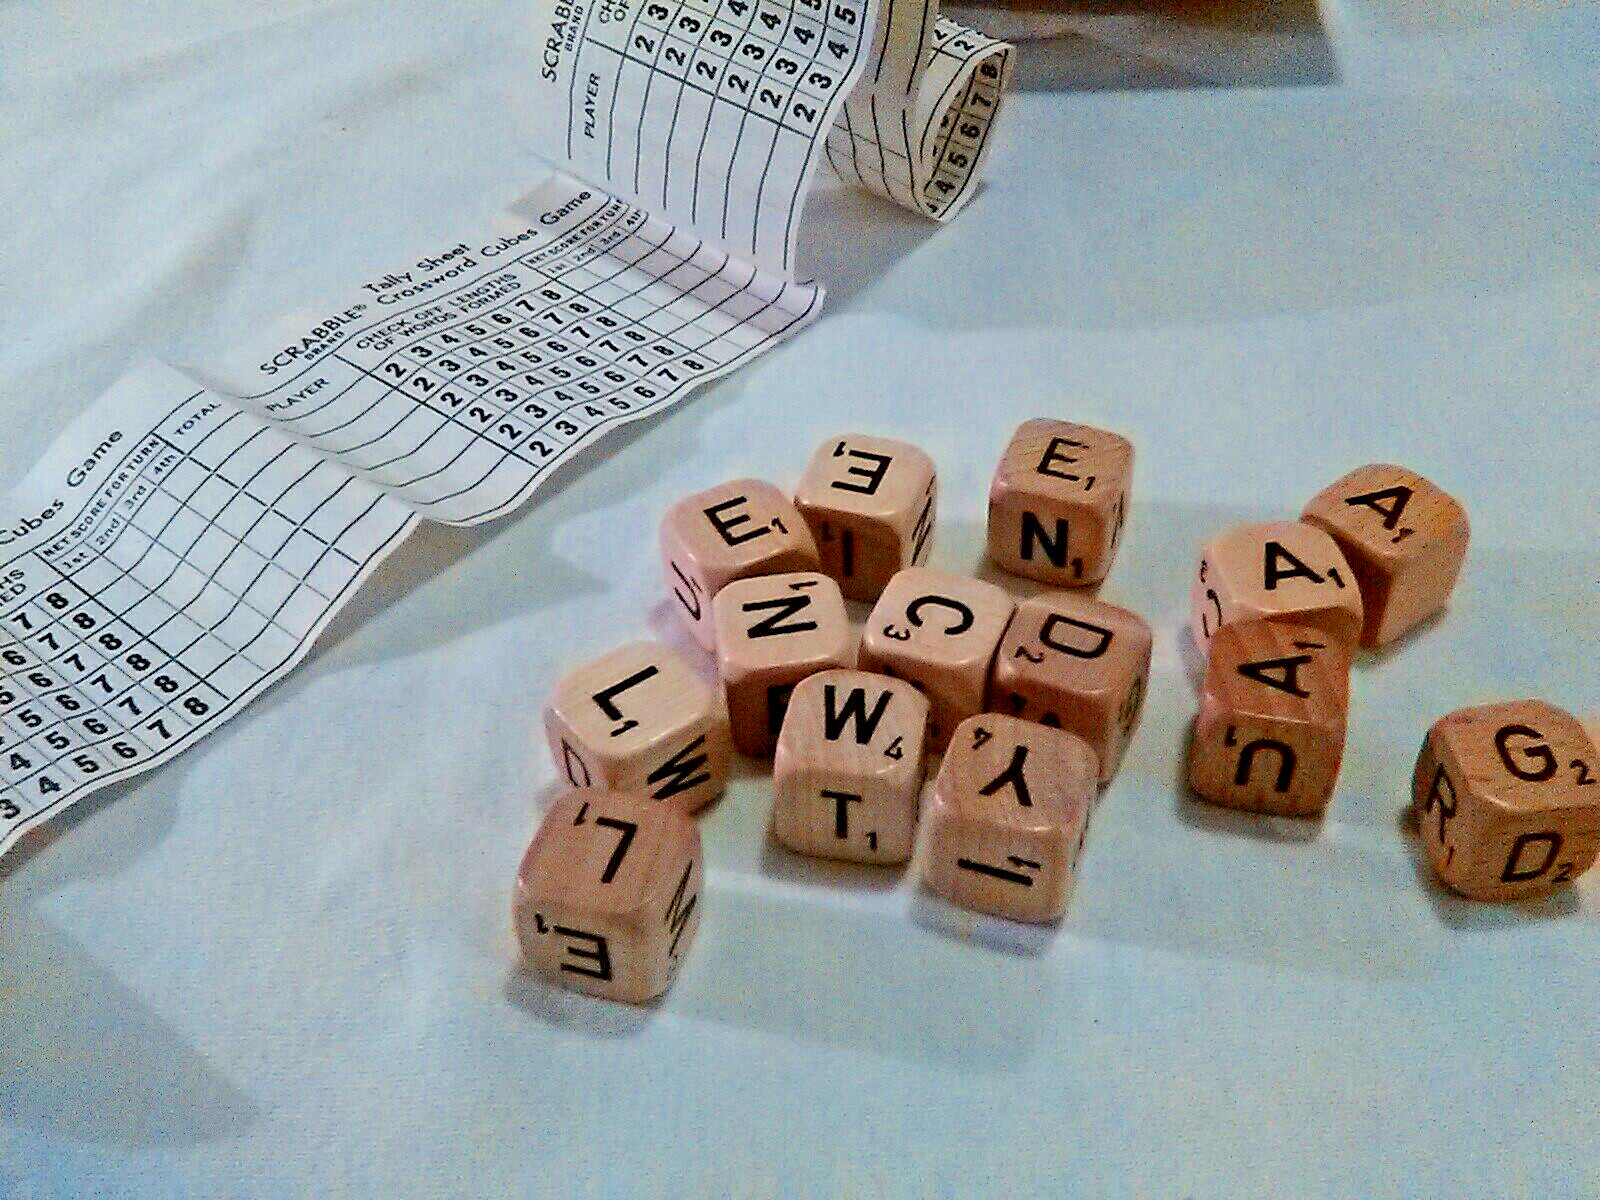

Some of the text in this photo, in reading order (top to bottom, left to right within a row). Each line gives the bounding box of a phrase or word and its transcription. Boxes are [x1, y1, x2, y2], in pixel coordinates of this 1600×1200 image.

[635, 4, 668, 53] 2 3
[665, 16, 700, 66] 2 3
[696, 30, 732, 79] 2 3
[728, 12, 781, 94] 2 3 4
[760, 26, 814, 108] 2 3 4
[794, 5, 856, 123] 2 3 4 5
[585, 73, 600, 138] PLAYER
[960, 123, 980, 139] 6
[971, 92, 991, 107] 7
[362, 243, 471, 293] Tally Sheet
[377, 191, 591, 305] Crossword Cubes Game
[356, 319, 411, 349] CHECK
[448, 273, 518, 307] LENGTHS
[373, 282, 521, 351] OF WORDS FORMED
[385, 290, 561, 378] 2 3 4 5 6 7 8
[413, 303, 589, 392] 2 3 4 5 6 7 8
[440, 317, 617, 407] 2 3 4 5 6 7 8
[266, 378, 328, 412] PLAYER
[469, 331, 646, 422] 2 3 4 5 6 7 8
[499, 346, 674, 440] 2 3 4 5 6 7 8
[173, 402, 222, 436] TOTAL
[529, 360, 704, 457] 2 3 4 5 6 7 8
[67, 430, 123, 487] Game
[831, 450, 892, 495] E
[1037, 437, 1089, 481] E
[43, 439, 160, 557] NET SCORE FOR TURN
[703, 496, 771, 546] E
[1345, 485, 1413, 530] A
[62, 551, 88, 569] 1st
[96, 518, 121, 546] 2nd
[1020, 511, 1068, 567] N
[1264, 541, 1325, 590] A
[0, 583, 27, 606] ED
[11, 593, 68, 629] 7 8
[906, 595, 974, 635] C
[2, 613, 96, 666] 6 7 8
[28, 633, 123, 687] 6 7 8
[1039, 613, 1113, 659] D
[17, 654, 151, 728] 5 6 7 8
[593, 665, 659, 722] L
[1237, 654, 1312, 699] A
[11, 676, 179, 770] 4 5 6 7 8
[825, 684, 893, 744] W
[39, 697, 208, 794] 4 5 6 7 8
[1496, 725, 1596, 785] G 2
[978, 745, 1033, 807] Y
[821, 789, 862, 839] T
[1501, 832, 1563, 883] D
[553, 925, 613, 981] E
